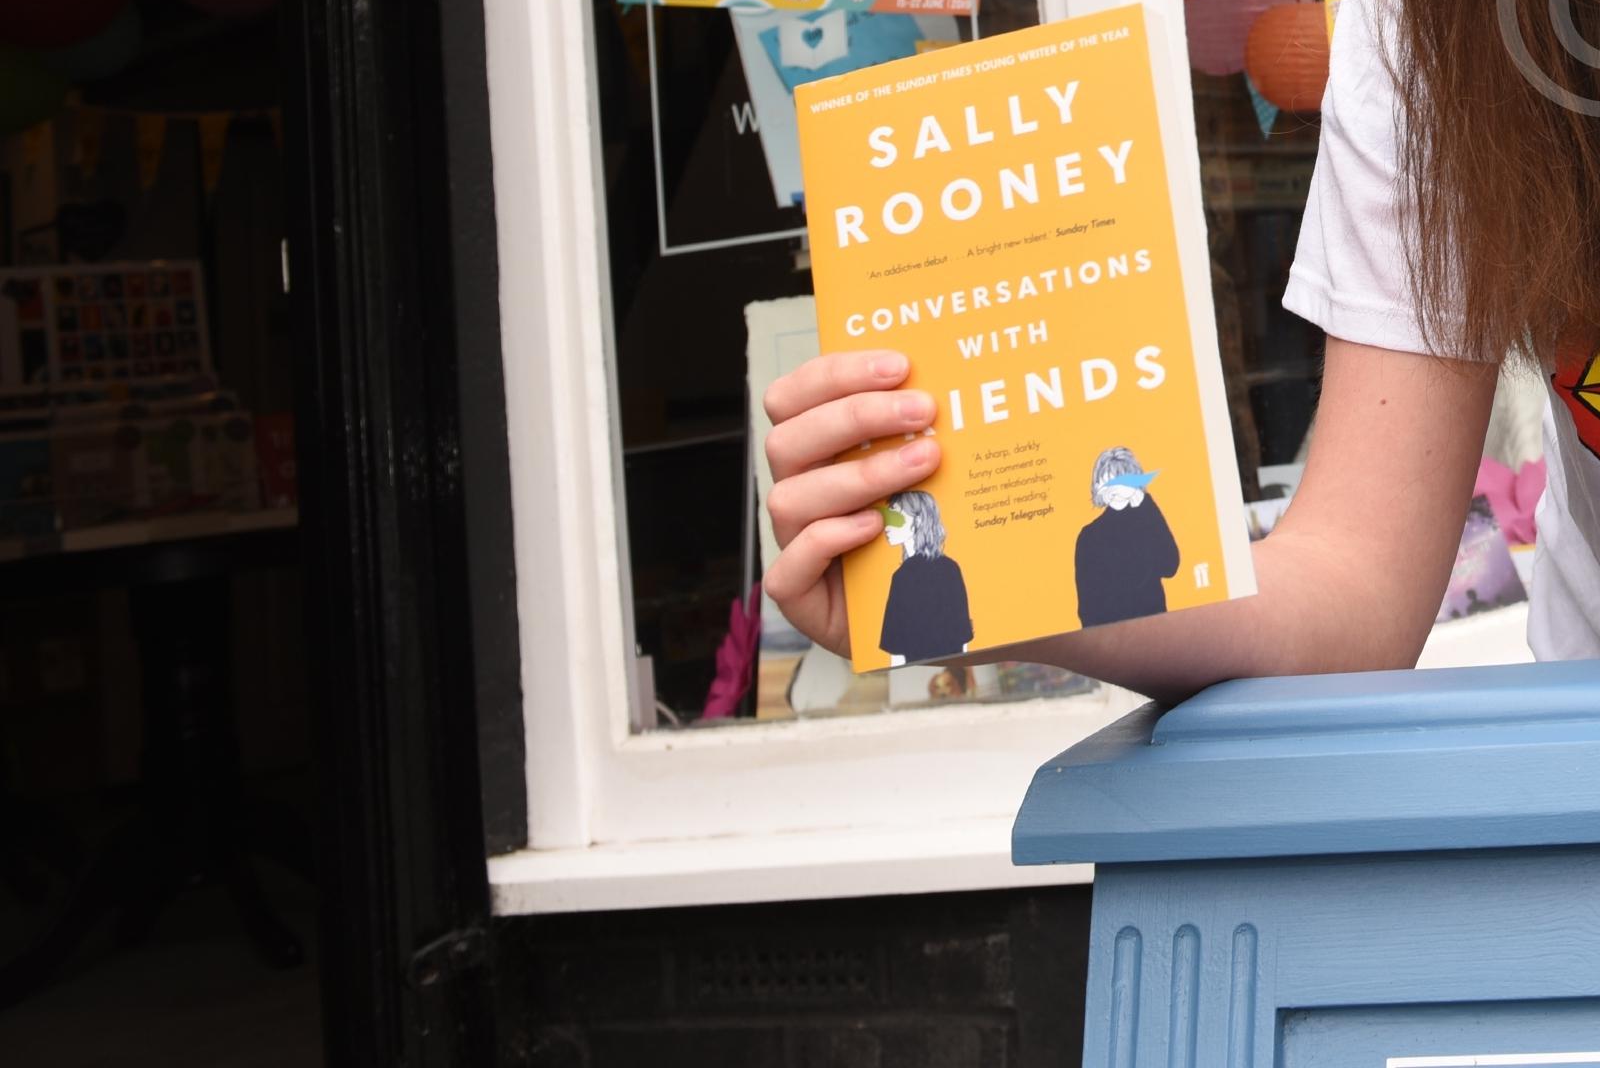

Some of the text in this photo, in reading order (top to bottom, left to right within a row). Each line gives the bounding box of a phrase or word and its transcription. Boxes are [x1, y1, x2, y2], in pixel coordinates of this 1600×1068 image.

[810, 26, 1130, 114] WINNER OF THE SUNDAY TIMES YOUNG WRITER OF THE YEAR
[867, 80, 1080, 168] SALLY
[834, 140, 1134, 248] ROONEY
[884, 260, 922, 276] addictive
[923, 255, 948, 269] debut
[966, 248, 975, 258] A
[976, 242, 1002, 258] bright
[1003, 239, 1021, 250] new
[1055, 222, 1089, 238] Sunday
[1090, 217, 1116, 229] Times
[845, 249, 1152, 337] CONVERSATIONS
[957, 320, 1049, 359] WITH
[860, 345, 1167, 451] IENDS
[968, 457, 1047, 480] funny comment on
[1013, 440, 1040, 454] darkly
[964, 472, 1054, 498] modern relationships
[972, 495, 1010, 513] Required
[974, 503, 1055, 530] Sunday Telegraph
